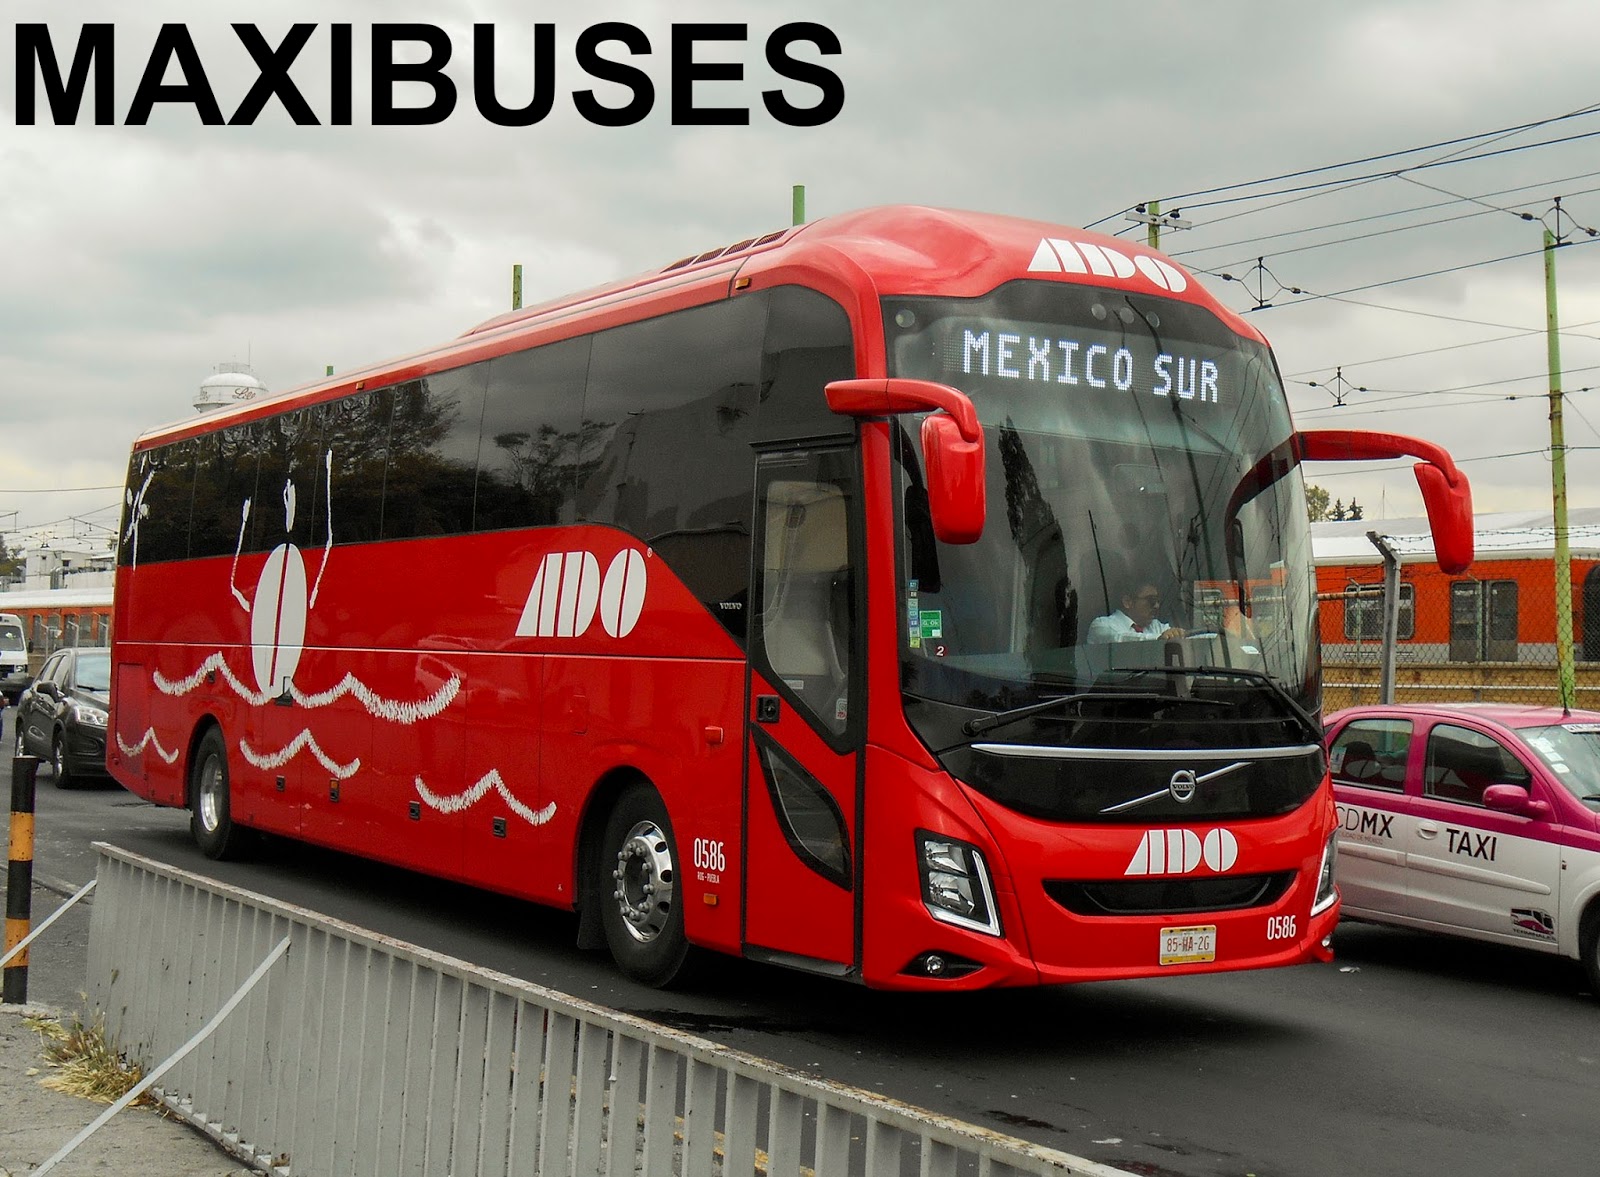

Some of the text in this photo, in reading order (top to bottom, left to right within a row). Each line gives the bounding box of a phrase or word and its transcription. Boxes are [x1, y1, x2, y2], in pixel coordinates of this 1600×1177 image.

[1027, 238, 1188, 293] ADO
[963, 329, 1219, 403] MEXICO SUR
[515, 548, 647, 638] ADO
[719, 602, 742, 610] VOLVO
[936, 645, 945, 656] 2
[694, 838, 725, 871] 0586
[1124, 828, 1238, 875] ADO
[1446, 827, 1497, 861] TAXI
[1267, 915, 1296, 940] 0586
